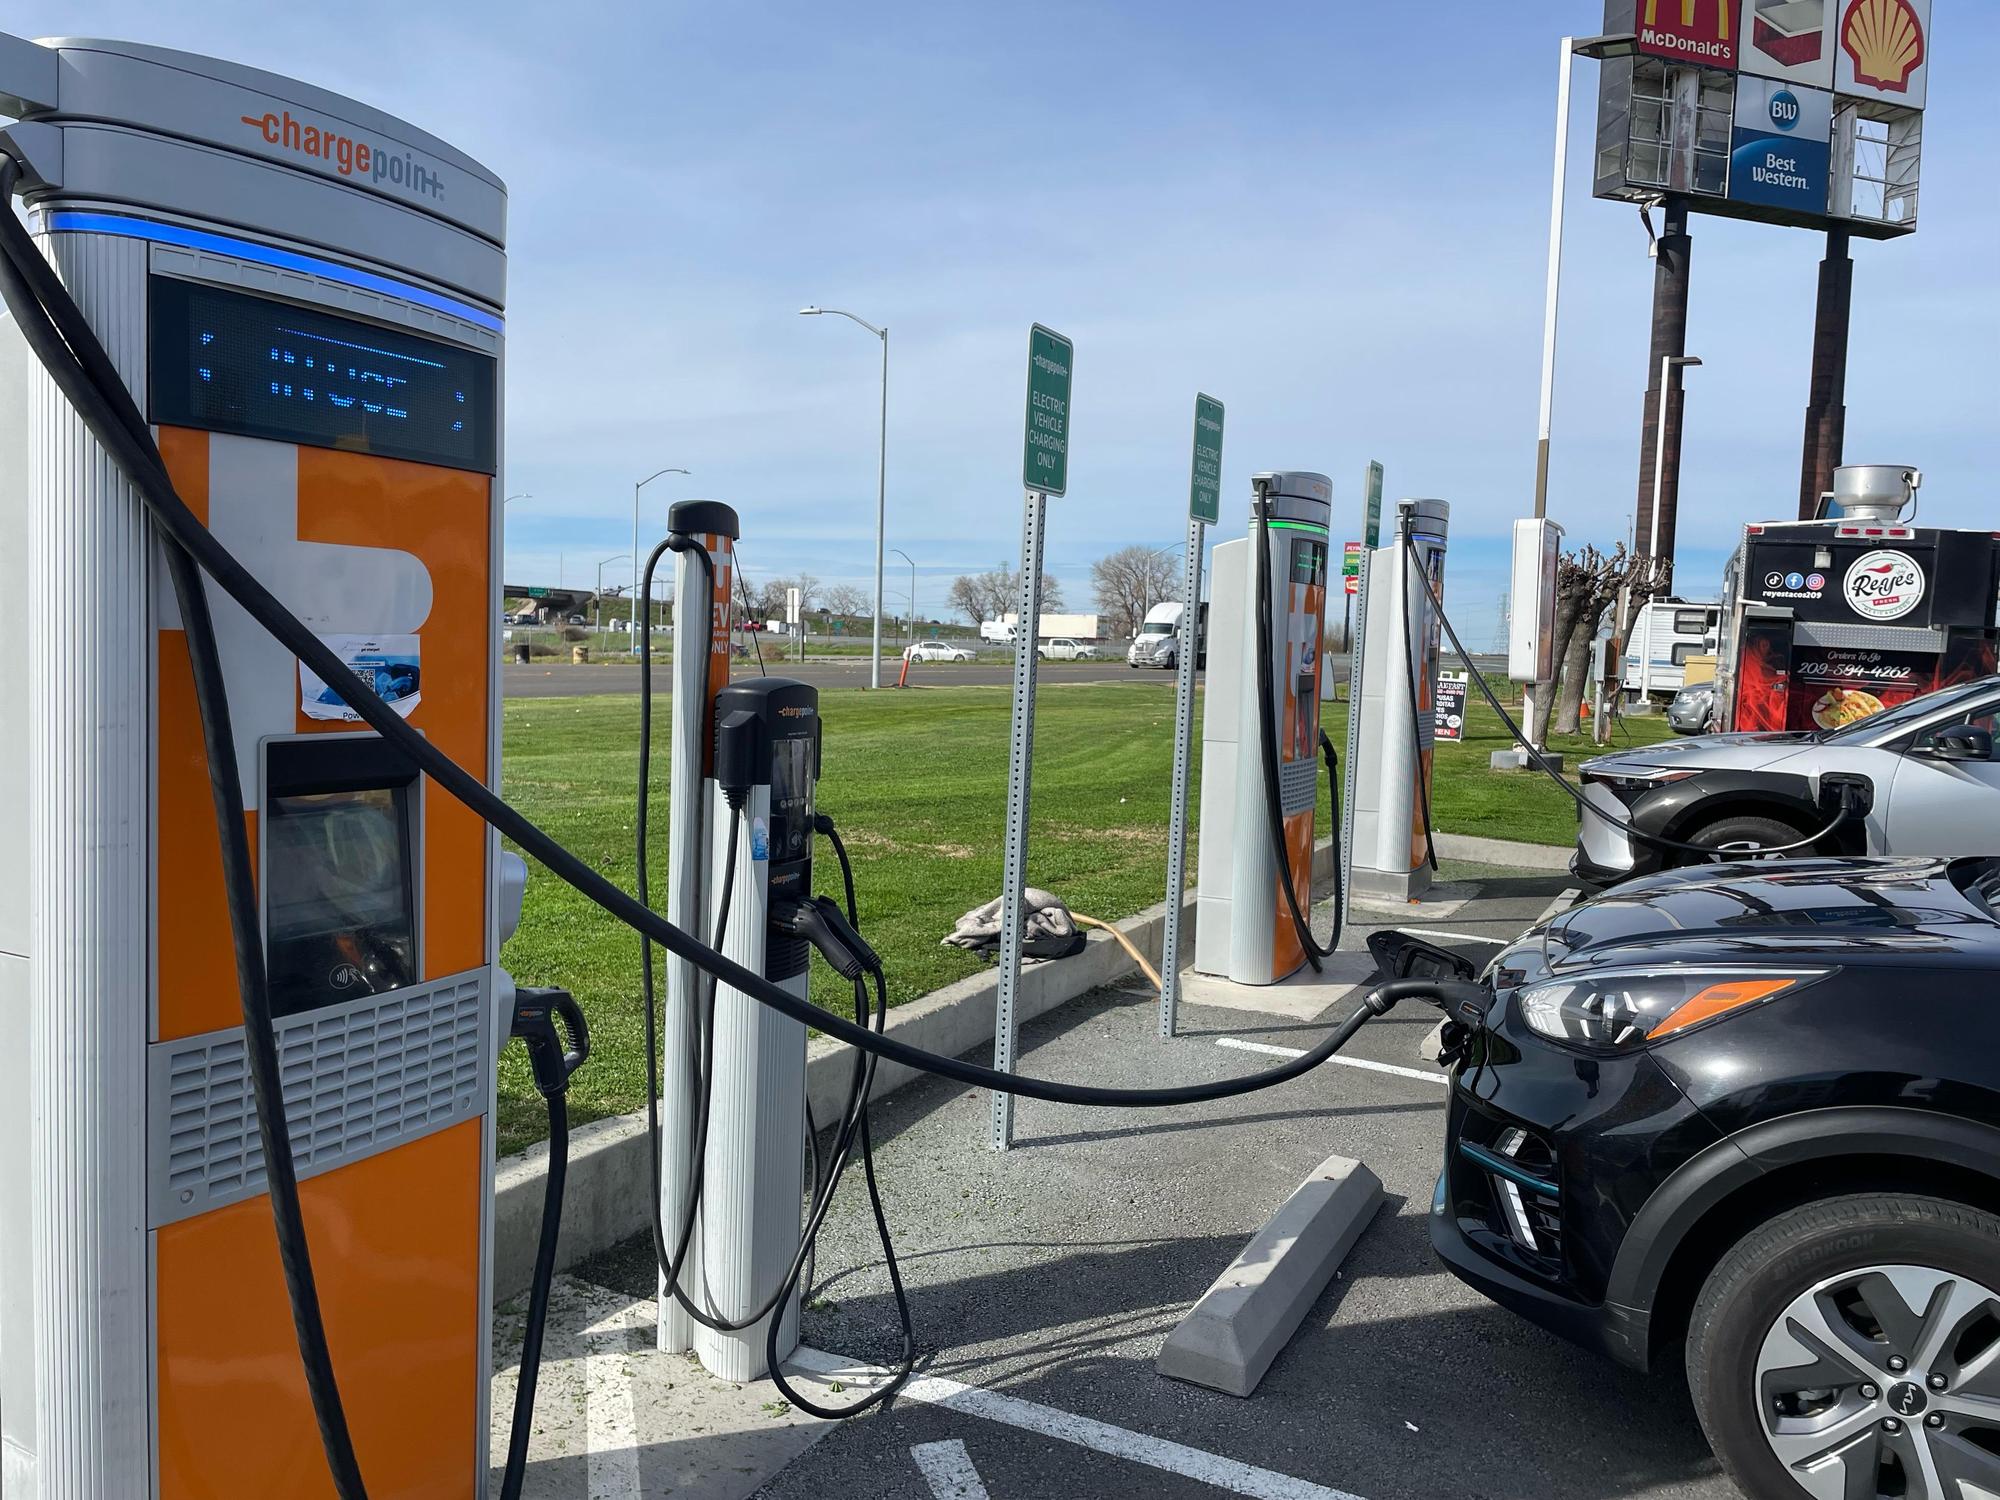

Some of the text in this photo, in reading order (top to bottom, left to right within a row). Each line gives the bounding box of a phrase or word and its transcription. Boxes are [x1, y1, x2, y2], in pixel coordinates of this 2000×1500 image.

[1640, 28, 1731, 59] McDonald's
[1771, 100, 1798, 121] BW
[241, 111, 445, 200] chargepoint
[1765, 153, 1796, 173] Best
[1752, 165, 1808, 190] Western
[1033, 390, 1065, 416] ELECTRIC
[1033, 410, 1063, 434] VEHICLE
[1029, 429, 1065, 454] CHARGING
[1037, 453, 1056, 470] ONLY
[1762, 590, 1823, 600] reyestacos209
[1851, 572, 1915, 598] Reyes
[1827, 650, 1857, 661] Orders
[1858, 651, 1867, 661] To
[1797, 661, 1912, 679] 209-594-4262
